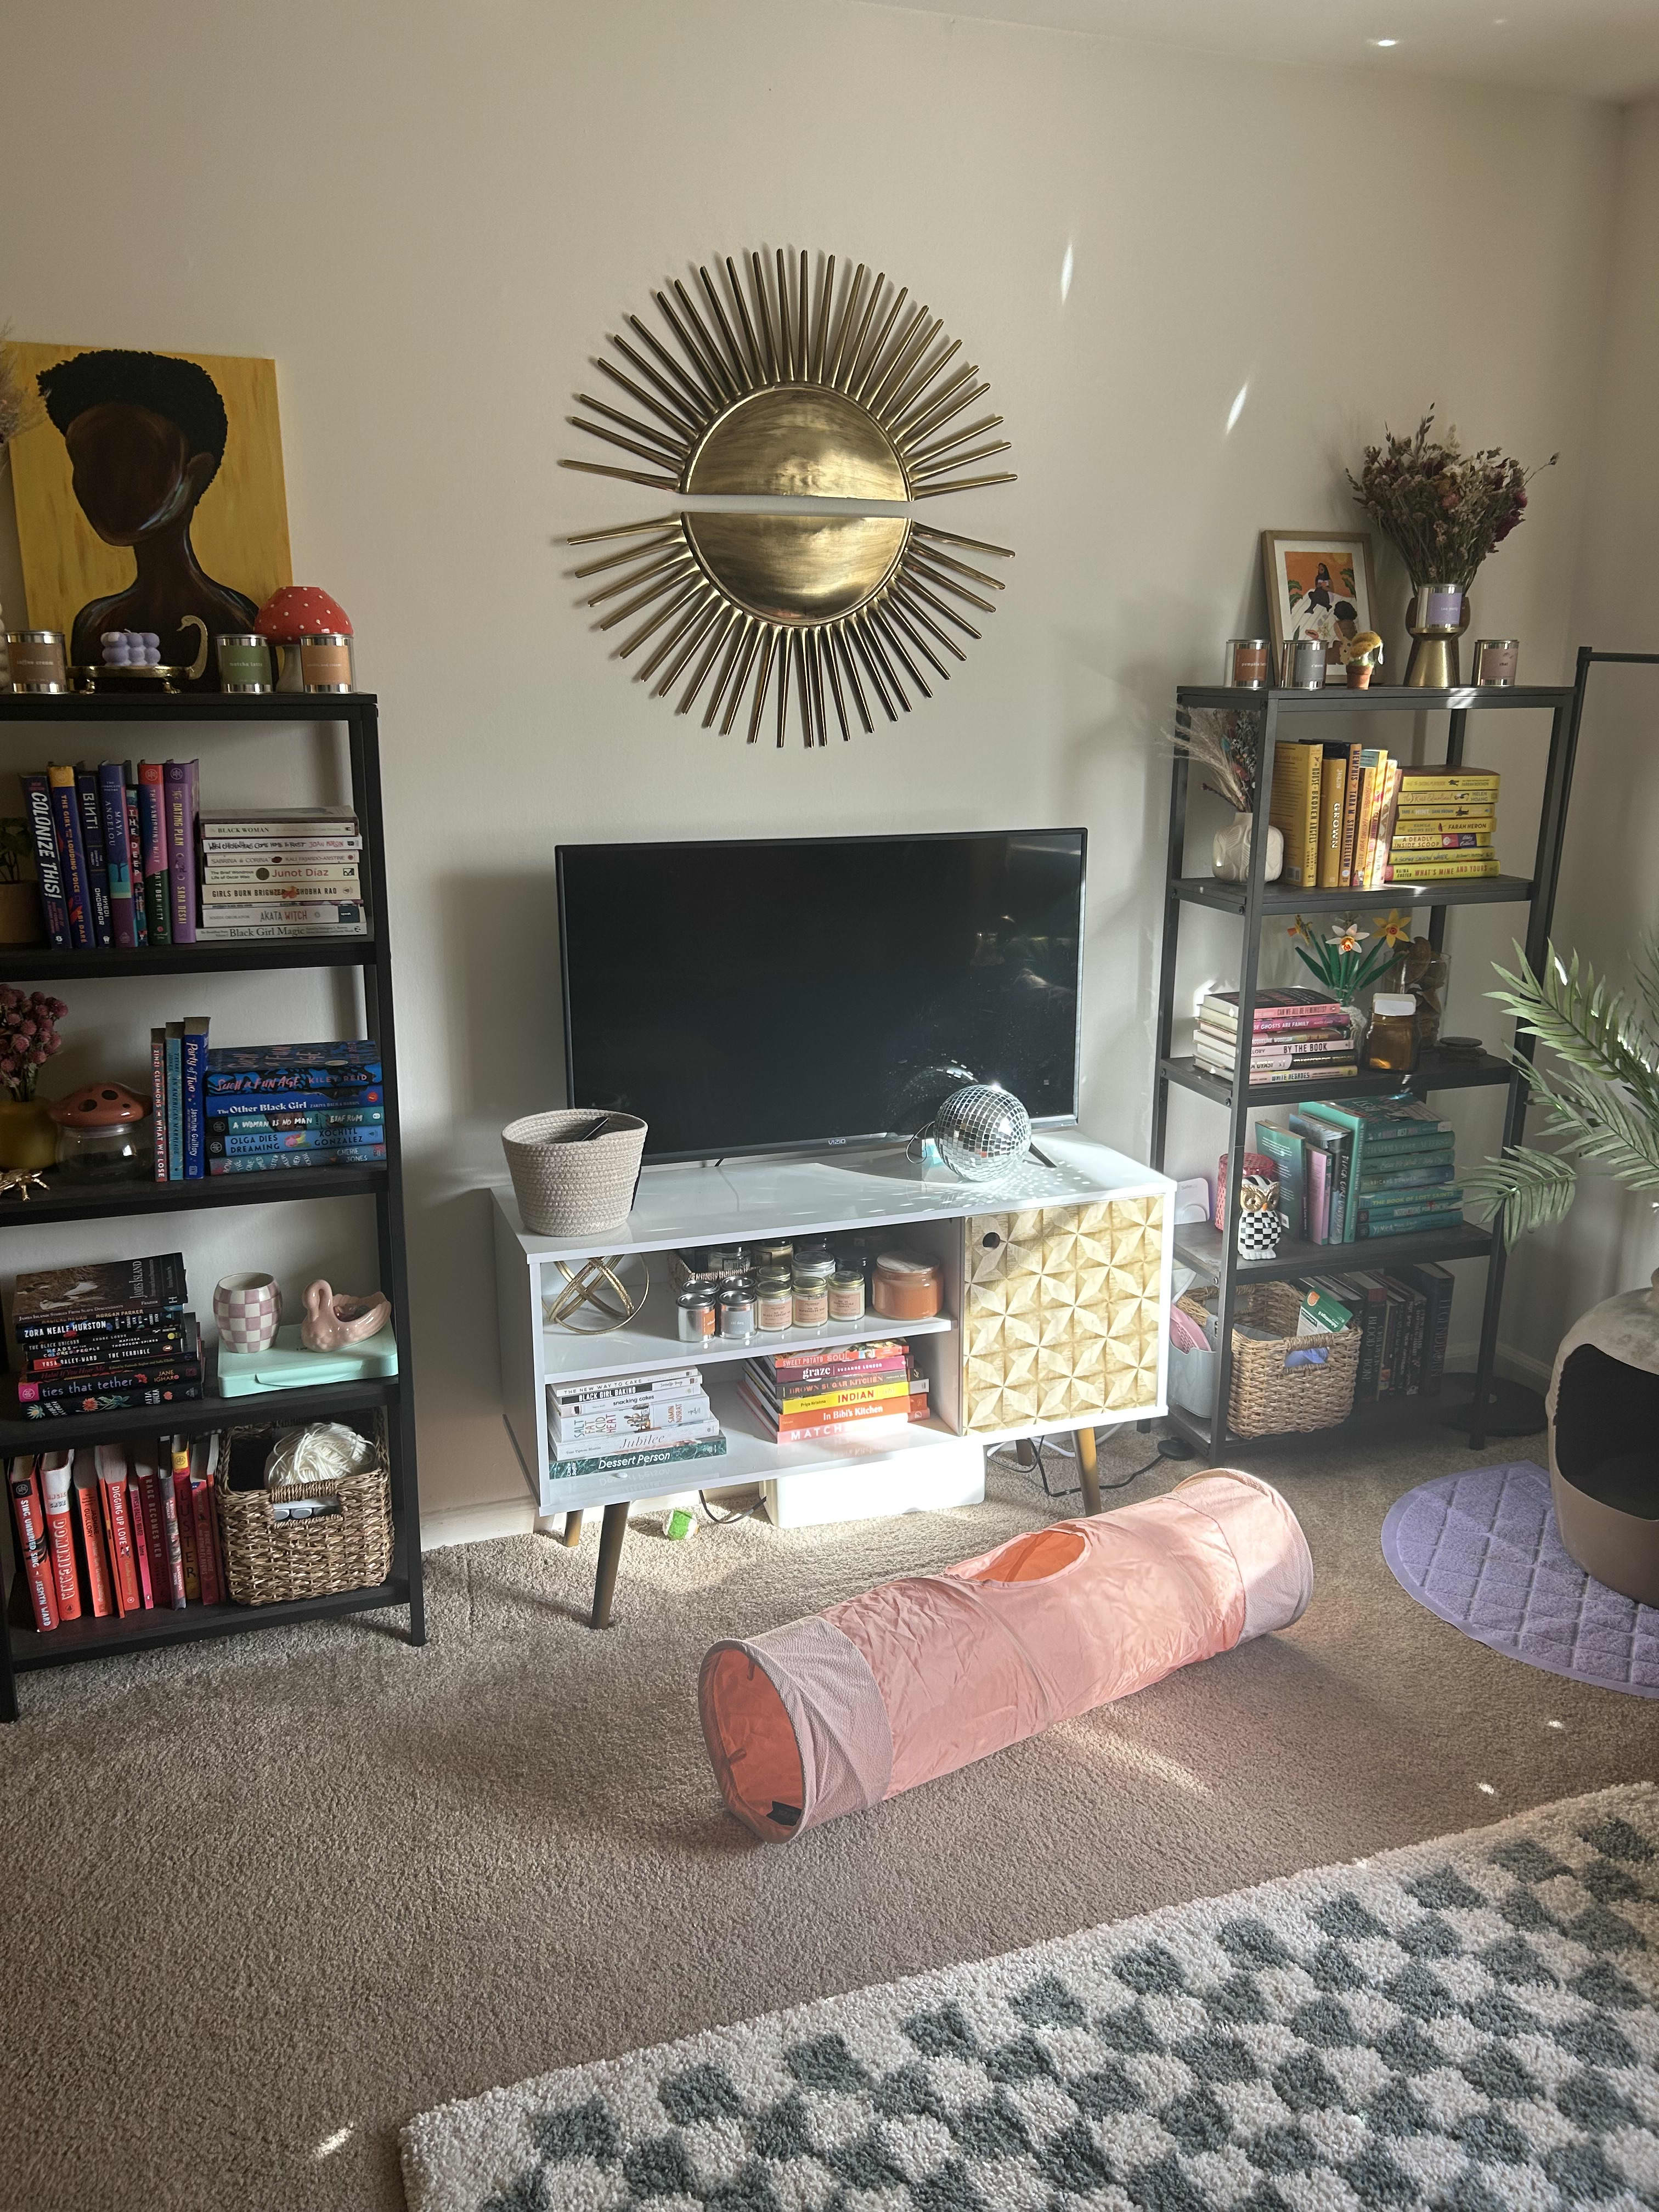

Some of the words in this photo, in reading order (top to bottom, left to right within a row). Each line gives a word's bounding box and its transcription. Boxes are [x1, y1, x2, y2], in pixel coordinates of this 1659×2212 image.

[1351, 750, 1361, 781] MEMPHIS
[1311, 767, 1320, 786] HOUSE
[1310, 791, 1319, 820] BROKEN
[1347, 790, 1358, 807] TARA
[128, 809, 137, 836] THE
[1346, 809, 1356, 817] M.
[31, 792, 55, 858] COLONIZE
[105, 800, 116, 847] ANGELOU
[114, 811, 123, 836] MAYA
[1308, 822, 1318, 845] ANGELS
[1361, 817, 1369, 840] HATING
[1342, 819, 1355, 868] STRINGFELLOW
[131, 842, 142, 876] DEEP
[40, 862, 62, 899] THIS!
[272, 868, 302, 878] Junot
[1414, 868, 1437, 876] WHAT'S
[254, 888, 286, 896] BRIGHTER
[295, 887, 321, 895] SHOBHA
[94, 888, 105, 926] OKORAFOR
[229, 928, 253, 937] Black
[256, 927, 275, 936] Girl
[276, 926, 305, 936] Magic
[186, 1042, 199, 1066] Party
[187, 1066, 198, 1075] of
[1271, 1073, 1287, 1081] WHITE
[1288, 1072, 1311, 1080] NEGROES
[154, 1070, 162, 1108] CLEMMONS
[186, 1075, 198, 1092] Two
[229, 1105, 257, 1114] Other
[259, 1103, 287, 1112] Black
[287, 1101, 307, 1110] Girl
[155, 1119, 163, 1142] WHAT
[230, 1136, 256, 1146] OLGA
[258, 1133, 279, 1143] DIES
[318, 1127, 359, 1138] XOCHITL
[157, 1143, 164, 1155] WE
[189, 1133, 200, 1157] Guillory
[230, 1143, 280, 1154] DREAMING
[314, 1136, 363, 1147] GONZALEZ
[336, 1148, 360, 1156] CHERIE
[346, 1154, 369, 1163] JONES
[128, 1260, 144, 1284] ISLAND
[129, 1282, 148, 1300] JAMES
[24, 1328, 45, 1339] ZORA
[47, 1324, 70, 1335] NEALE
[71, 1320, 106, 1333] HURSTON
[1366, 1316, 1378, 1347] BLOOD
[1430, 1299, 1452, 1378] LEGENDBORN
[42, 1359, 58, 1368] YRSA
[60, 1355, 98, 1365] DALEY-WARD
[122, 1348, 151, 1358] TERRIBLE
[71, 1346, 100, 1355] PEOPLE
[782, 1358, 802, 1367] SWEET
[802, 1356, 823, 1365] POTATO
[826, 1352, 850, 1362] SOUL
[1361, 1358, 1373, 1383] BONE
[42, 1386, 64, 1398] ties
[69, 1380, 93, 1394] that
[97, 1376, 133, 1391] tether
[788, 1385, 819, 1395] BROWN
[820, 1380, 848, 1390] SUGAR
[849, 1374, 884, 1387] KITCHEN
[612, 1397, 638, 1407] snacking
[639, 1394, 655, 1402] cakes
[837, 1390, 874, 1404] INDIAN
[675, 1403, 684, 1423] NOSRAT
[823, 1412, 832, 1421] In
[833, 1409, 854, 1419] Bibi's
[854, 1405, 884, 1417] Kitchen
[573, 1418, 585, 1439] SALT
[584, 1420, 595, 1439] FAT
[595, 1416, 606, 1435] ACID
[606, 1413, 617, 1434] HEAT
[597, 1454, 637, 1471] Dessert
[636, 1451, 671, 1465] Person
[145, 1479, 156, 1500] RAGE
[84, 1508, 94, 1538] GUILLORY
[90, 1509, 100, 1536] JASMINE
[148, 1502, 160, 1541] BECOMES
[179, 1489, 196, 1578] LUSTER
[52, 1518, 76, 1601] DOMINICANA
[153, 1542, 163, 1559] HER
[20, 1499, 30, 1517] SING,
[30, 1552, 40, 1568] SING
[35, 1580, 46, 1605] JESMYN
[41, 1607, 53, 1627] WARD
